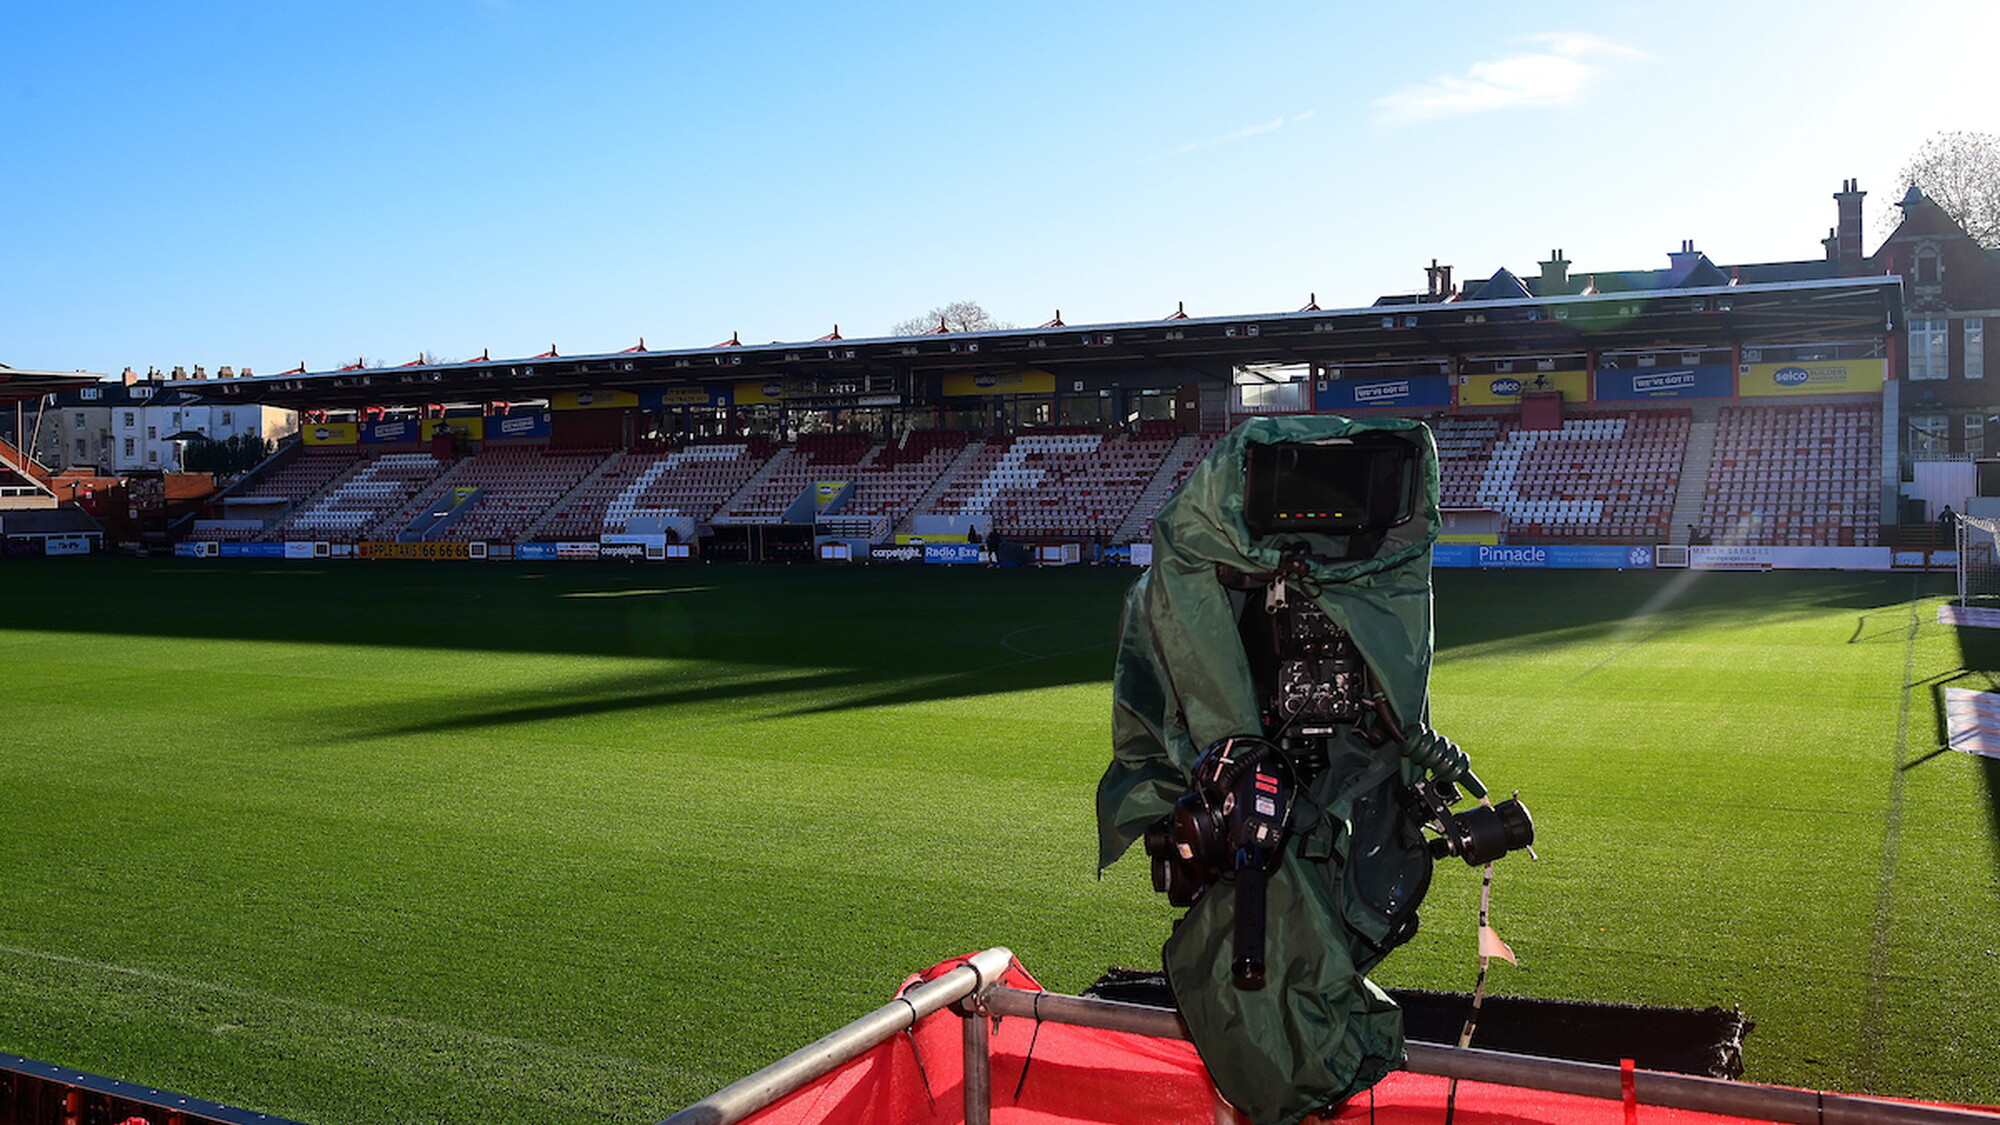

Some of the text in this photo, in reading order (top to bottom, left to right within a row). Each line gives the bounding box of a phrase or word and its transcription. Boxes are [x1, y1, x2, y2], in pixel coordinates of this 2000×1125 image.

[1637, 377, 1665, 388] WE'VE
[1665, 375, 1682, 384] GOT
[1774, 370, 1807, 382] selco
[1491, 381, 1520, 392] selco
[369, 544, 469, 557] APPLE TAXIS 66 66 66
[871, 547, 923, 560] carpetright
[925, 546, 978, 557] Radio Exe
[1479, 546, 1546, 561] Pinnacle
[1692, 547, 1769, 555] MARSH GARAGES
